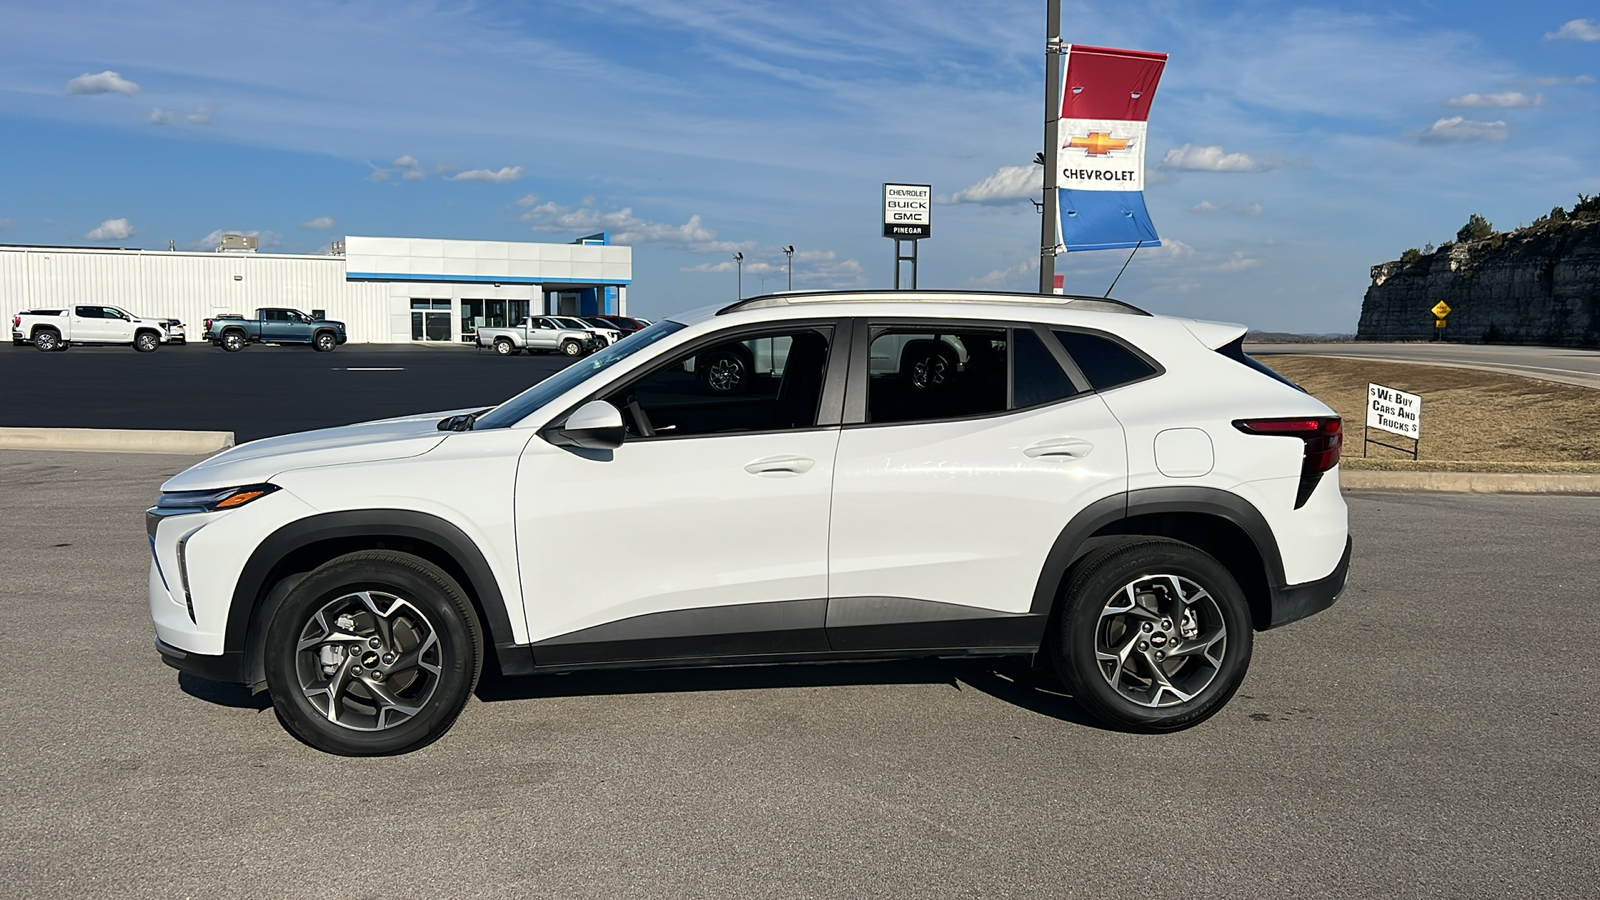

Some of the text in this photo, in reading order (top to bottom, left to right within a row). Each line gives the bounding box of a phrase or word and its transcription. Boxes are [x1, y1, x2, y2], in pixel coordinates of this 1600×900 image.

[1062, 168, 1135, 181] CHEVROLET
[888, 189, 928, 197] CHEVROLET
[888, 201, 928, 209] BUICK
[893, 212, 923, 221] GMC
[893, 226, 922, 234] PINEGAR
